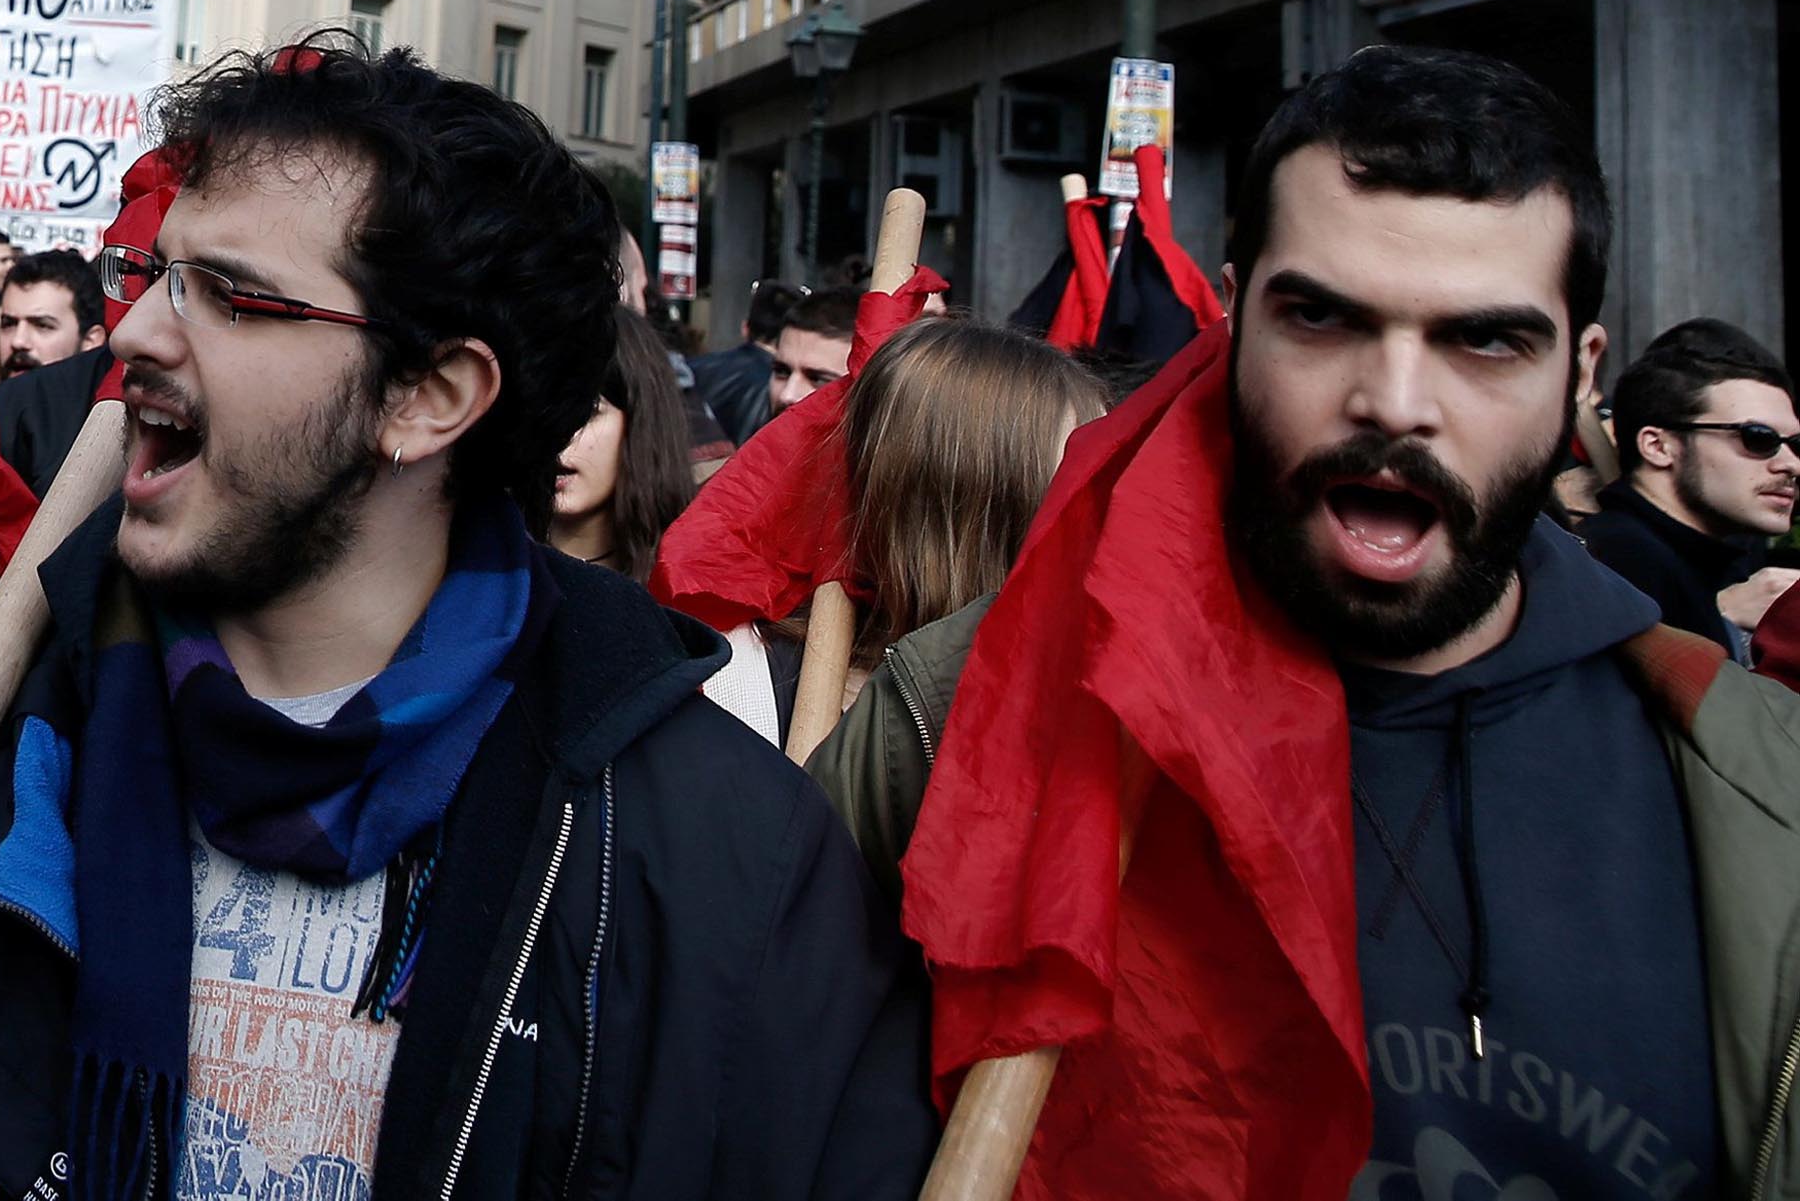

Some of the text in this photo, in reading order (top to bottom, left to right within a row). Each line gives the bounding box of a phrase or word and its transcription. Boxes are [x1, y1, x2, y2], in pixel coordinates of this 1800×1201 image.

[38, 84, 142, 139] ΠΤΥΧΙΑ
[254, 992, 286, 1008] ROAD
[289, 998, 329, 1015] MOTOR
[233, 1008, 326, 1074] LAST
